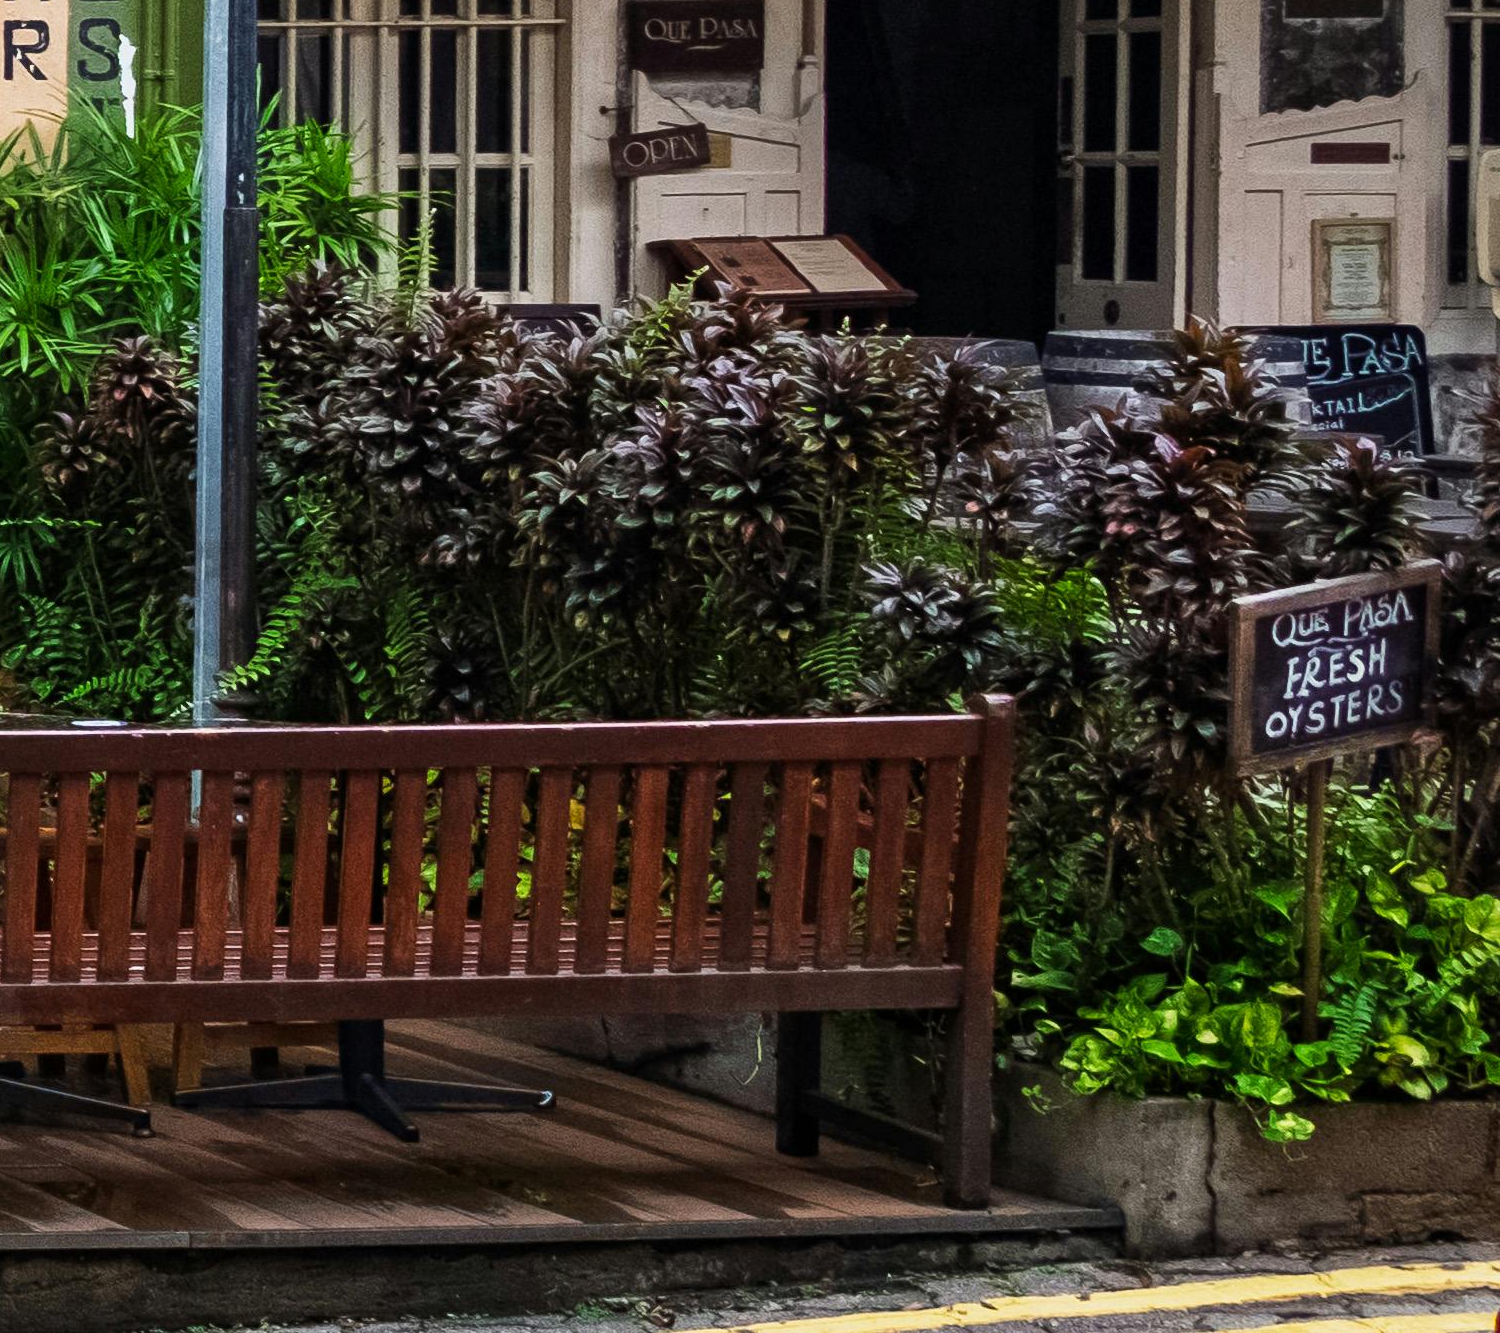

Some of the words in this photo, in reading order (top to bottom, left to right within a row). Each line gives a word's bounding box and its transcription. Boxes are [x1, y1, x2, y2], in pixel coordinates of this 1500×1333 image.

[644, 18, 691, 43] QUE
[700, 18, 758, 40] PASA
[623, 133, 699, 167] OPEN
[1271, 611, 1330, 647] QUE
[1343, 589, 1414, 637] PASA
[1283, 637, 1388, 700] FRESH
[1264, 679, 1404, 739] OYSTERS
